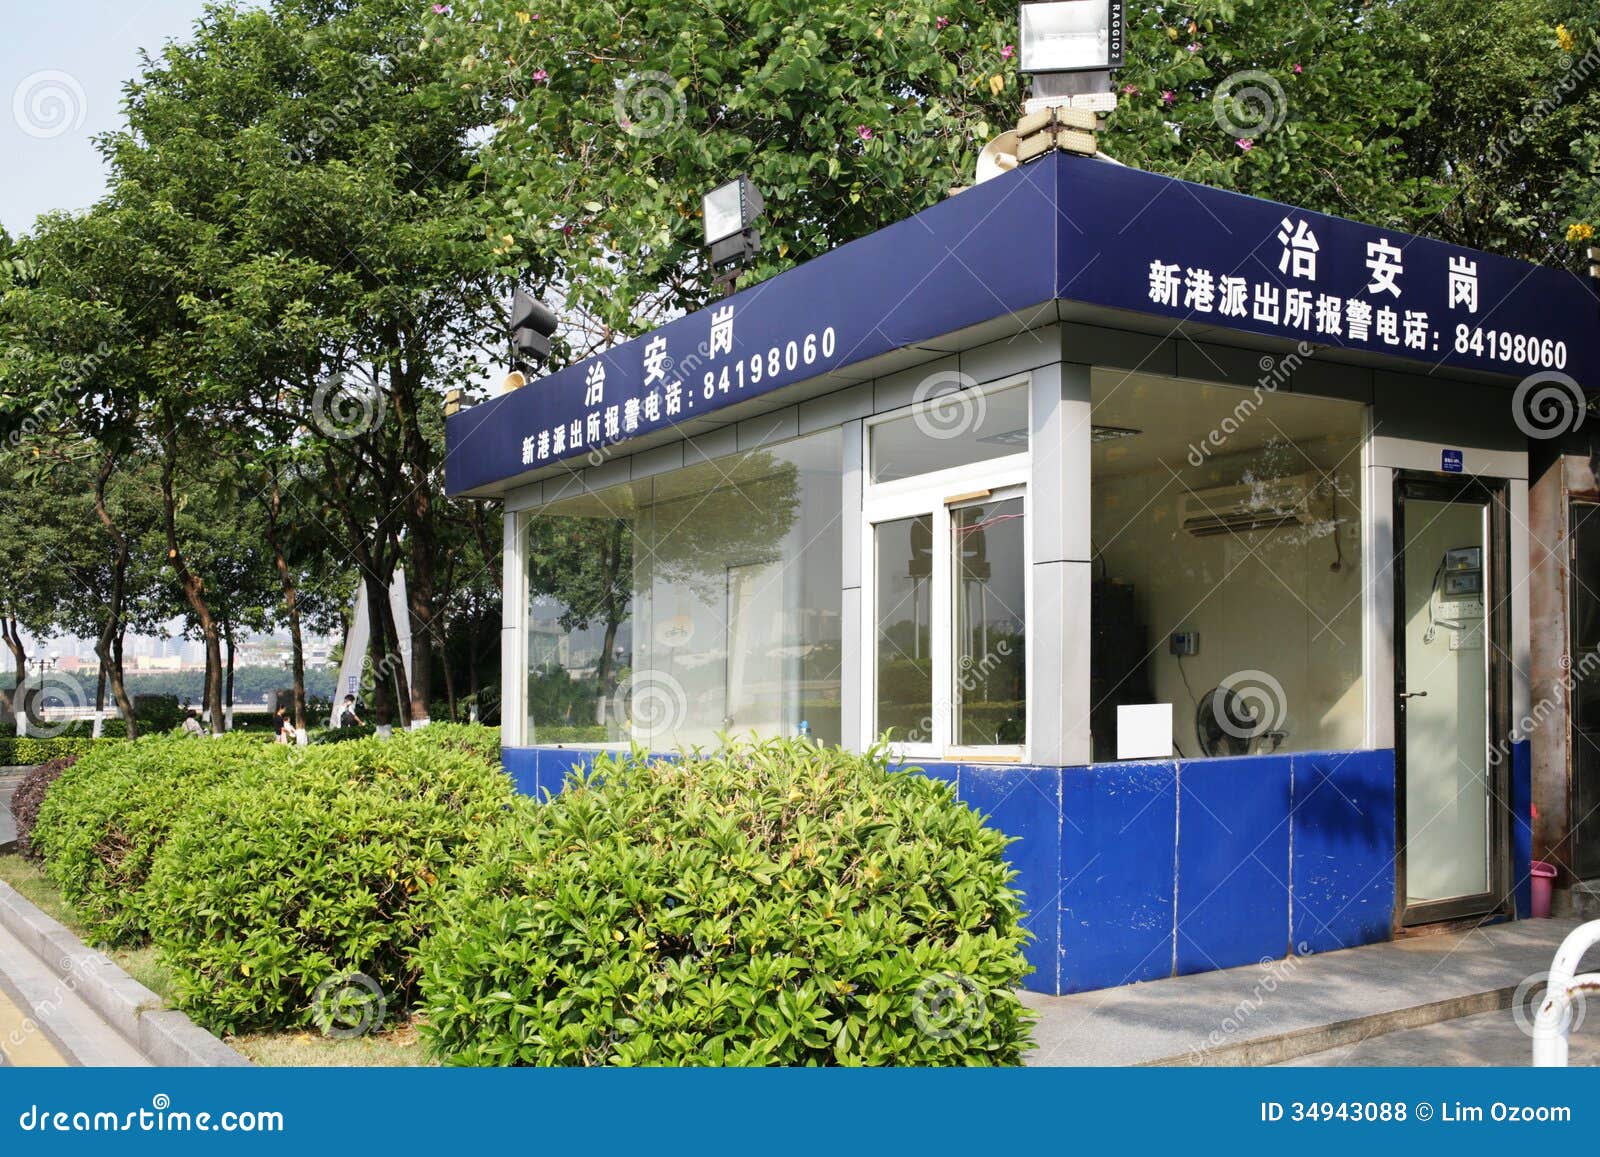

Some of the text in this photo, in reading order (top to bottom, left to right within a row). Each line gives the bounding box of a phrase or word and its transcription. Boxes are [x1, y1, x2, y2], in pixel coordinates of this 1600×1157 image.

[1111, 4, 1121, 50] RAGGIO
[1277, 216, 1478, 313] 治安岗
[584, 305, 735, 407] 治安岗
